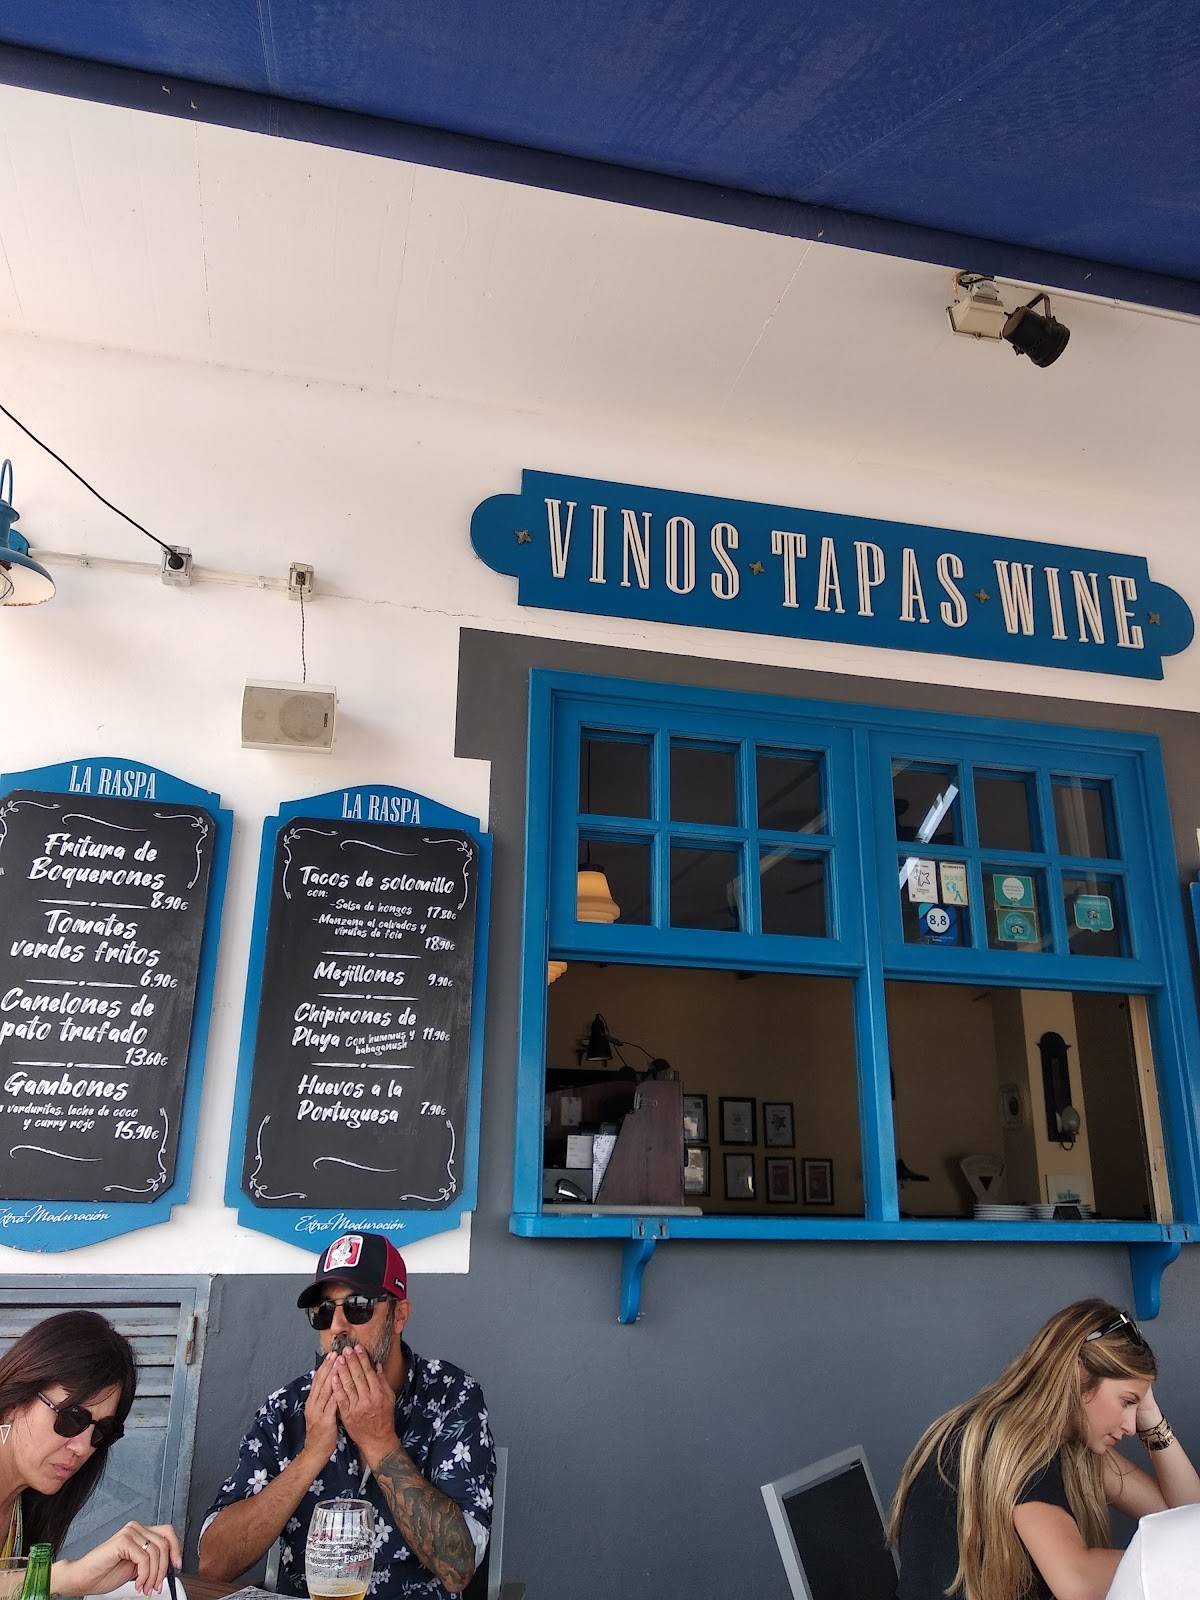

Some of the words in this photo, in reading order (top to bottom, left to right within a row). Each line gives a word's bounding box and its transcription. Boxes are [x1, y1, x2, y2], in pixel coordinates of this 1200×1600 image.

[544, 498, 741, 600] VINOS
[771, 530, 968, 628] TAPAS
[993, 559, 1145, 650] WINE
[69, 765, 91, 793] LA
[97, 768, 157, 800] RASPA
[342, 792, 362, 819] LA
[368, 795, 421, 824] RASPA
[44, 833, 126, 860] Fritura
[133, 840, 158, 862] de
[27, 856, 166, 891] Boquerones
[299, 865, 350, 888] Tacos
[356, 870, 374, 888] de
[380, 874, 454, 894] solomillo
[150, 891, 189, 911] 8.90€
[364, 901, 375, 912] de
[377, 902, 413, 917] hongos
[44, 909, 139, 939] Tomates
[334, 926, 367, 938] virutas
[370, 927, 381, 938] de
[384, 929, 403, 939] foie
[367, 918, 375, 928] al
[378, 919, 417, 932] calvados
[420, 923, 427, 934] y
[929, 914, 947, 927] 8,8
[10, 937, 86, 963] verdes
[94, 941, 161, 967] fritos
[140, 970, 179, 989] 6.90€
[313, 961, 405, 988] Mejillones
[0, 987, 123, 1019] Canelones
[130, 994, 155, 1017] de
[294, 1002, 392, 1028] Chipirones
[399, 1007, 417, 1026] de
[0, 1015, 51, 1045] pato
[59, 1017, 148, 1045] trufado
[291, 1025, 340, 1052] Playa
[368, 1031, 406, 1043] hummus
[409, 1029, 416, 1040] y
[124, 1047, 169, 1067] 13.60€
[355, 1041, 408, 1056] babaganush
[4, 1071, 129, 1101] Gambones
[298, 1074, 365, 1098] Huevos
[388, 1079, 402, 1098] la
[68, 1105, 94, 1117] leche
[98, 1105, 110, 1117] de
[113, 1108, 138, 1118] coco
[297, 1099, 399, 1129] Portuguesa
[24, 1119, 32, 1130] y
[35, 1119, 66, 1132] curry
[70, 1119, 95, 1132] rojo
[295, 1214, 330, 1234] Extra
